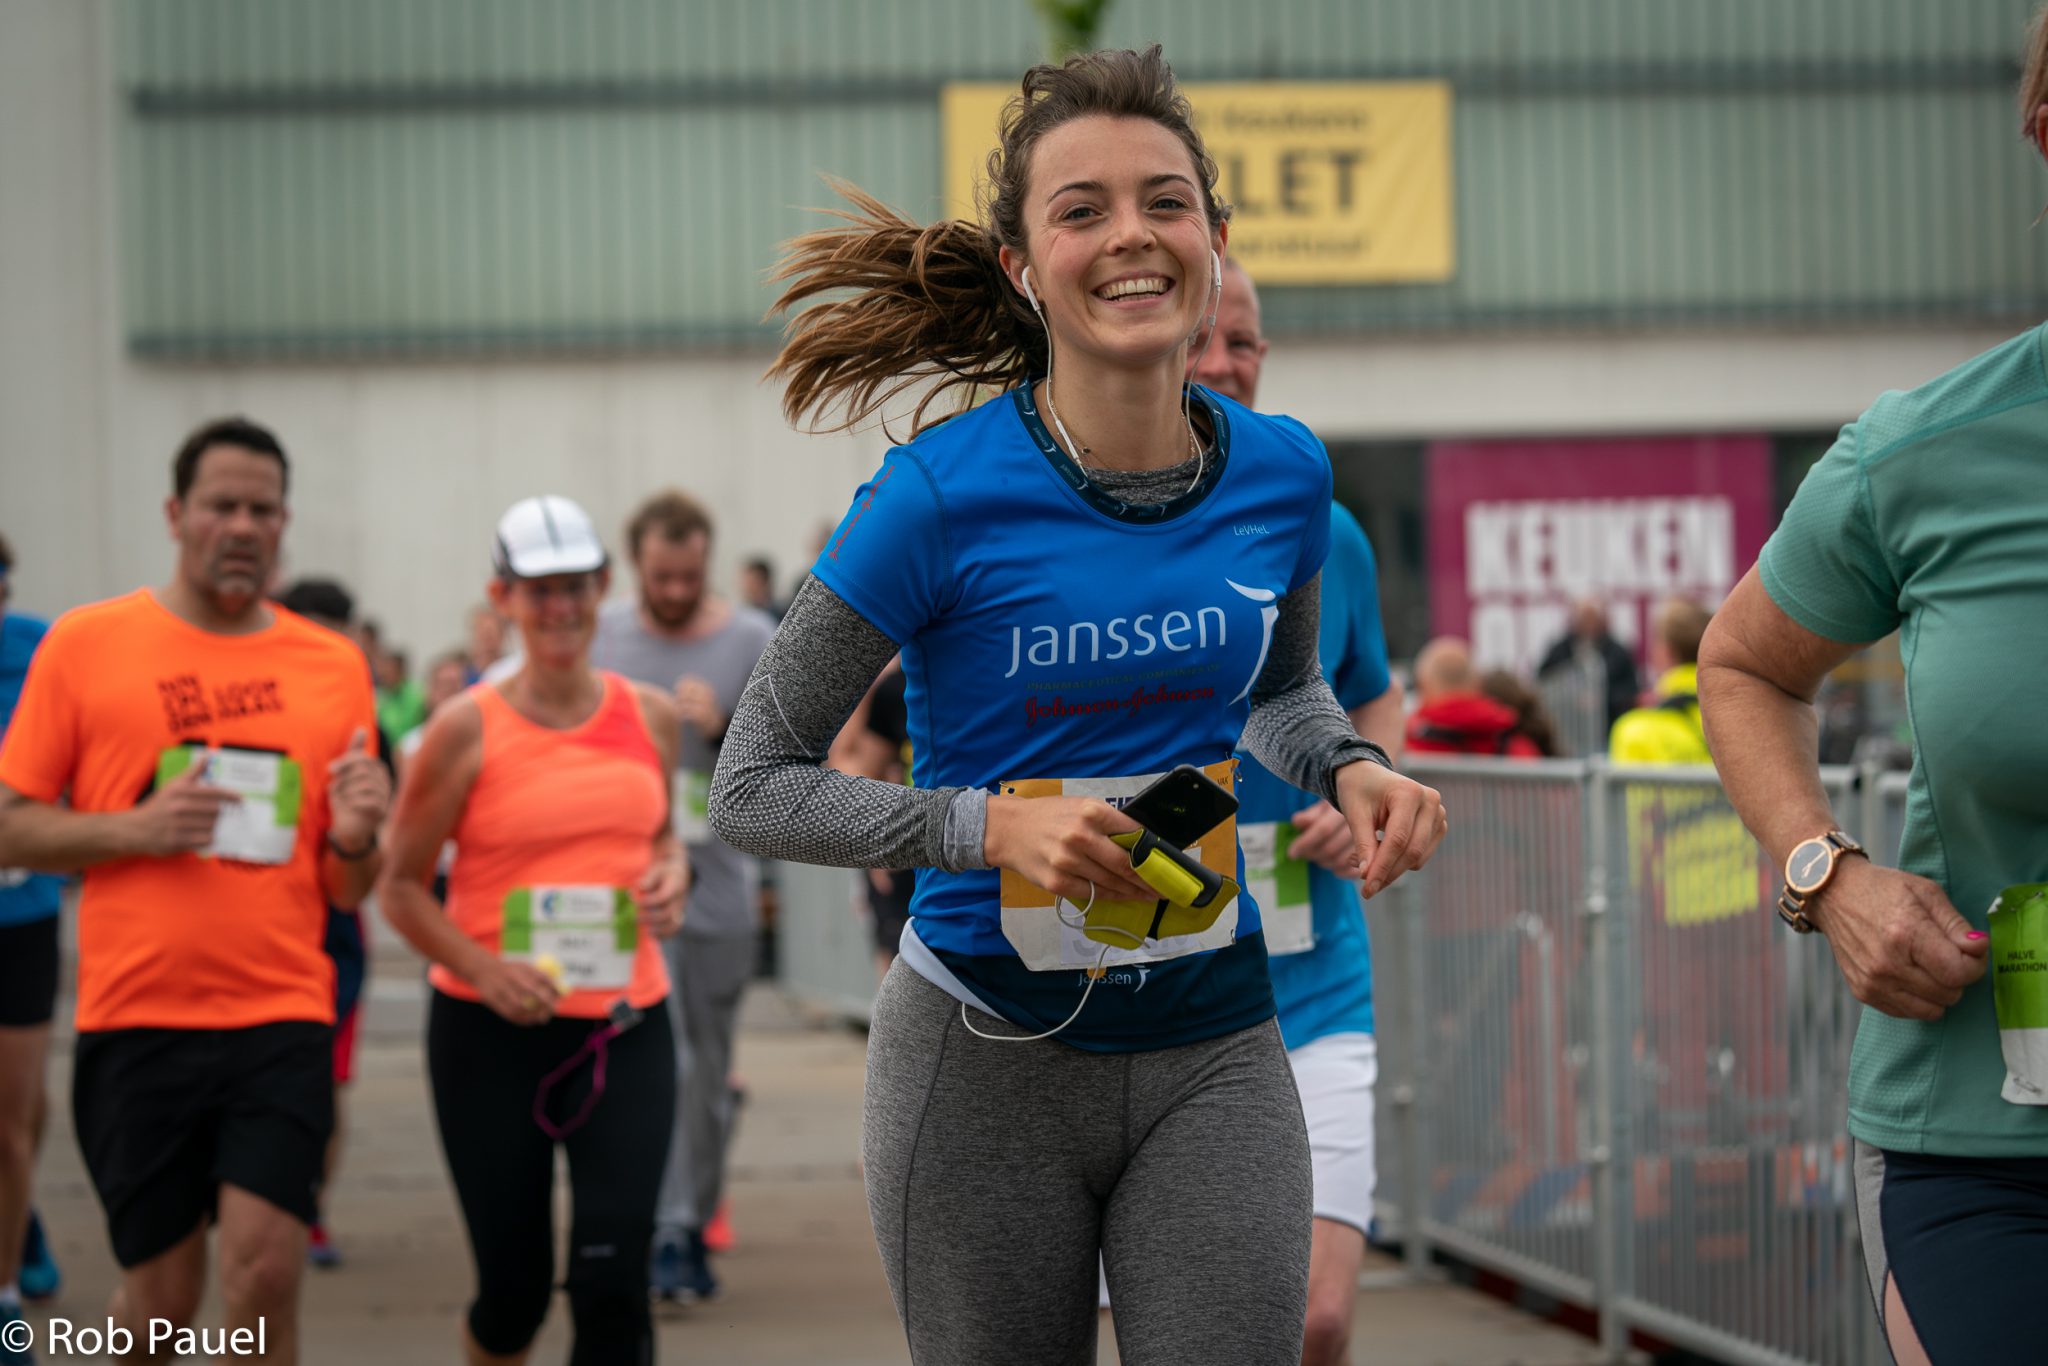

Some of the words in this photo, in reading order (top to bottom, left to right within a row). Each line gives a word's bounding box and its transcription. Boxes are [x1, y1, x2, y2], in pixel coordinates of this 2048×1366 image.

[1208, 147, 1370, 216] LET
[2007, 950, 2036, 961] HALVE
[1998, 962, 2048, 973] MARATHON
